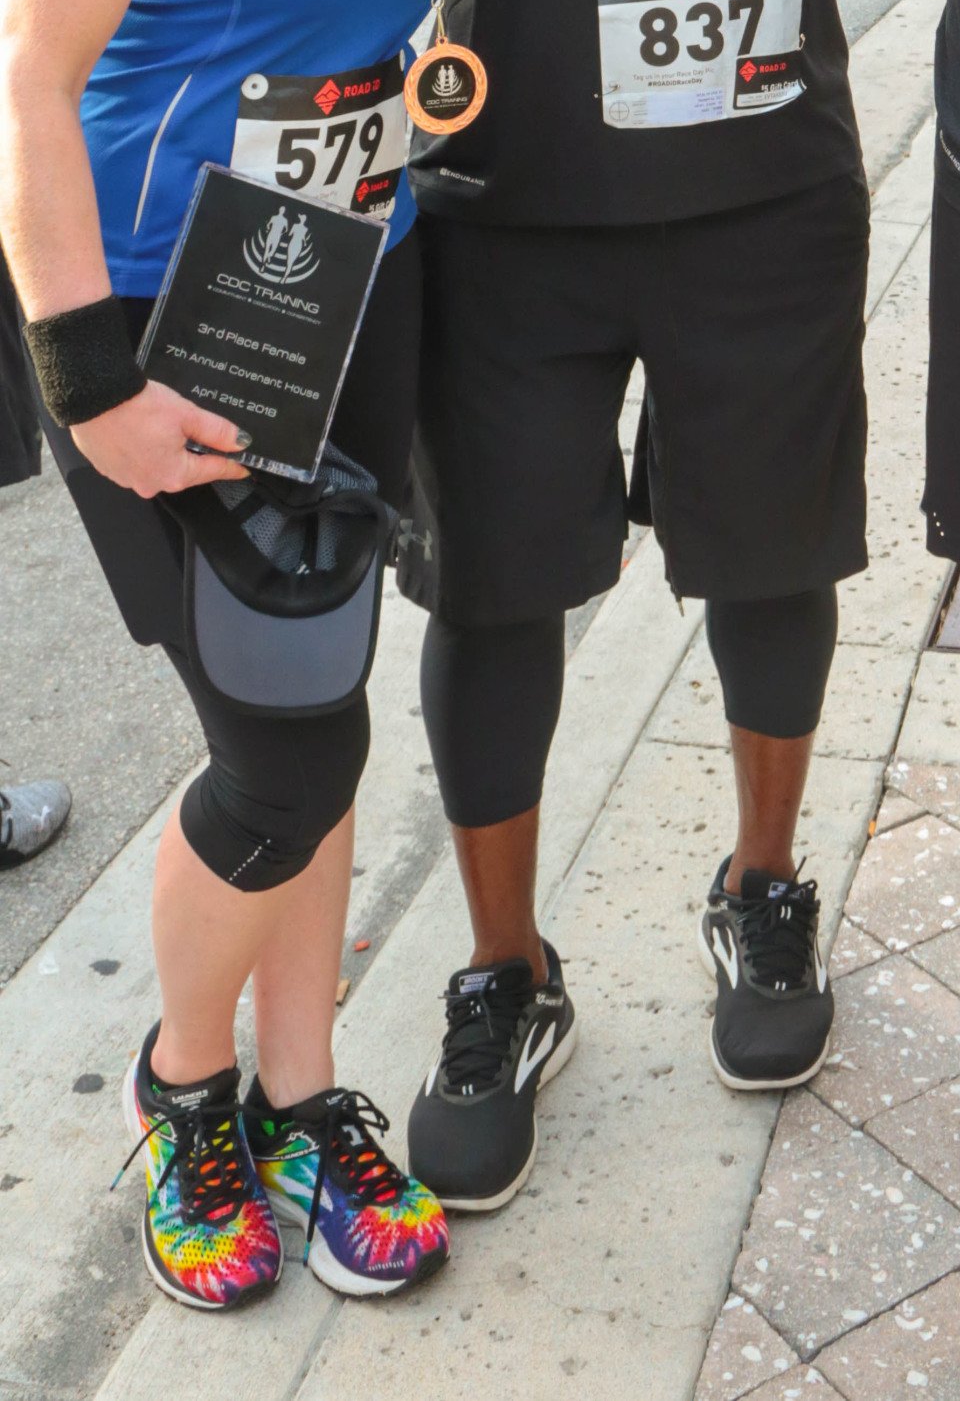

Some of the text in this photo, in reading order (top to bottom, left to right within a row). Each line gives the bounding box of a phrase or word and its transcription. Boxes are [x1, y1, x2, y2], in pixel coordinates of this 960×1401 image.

[760, 64, 779, 74] ROAD
[344, 82, 371, 98] ROAD
[275, 112, 384, 190] 579
[217, 273, 320, 314] CDC TRAINING
[197, 323, 306, 365] 3rd Place Female
[165, 345, 320, 400] 7th Annual Covenant House
[191, 385, 277, 418] April 21st 2018
